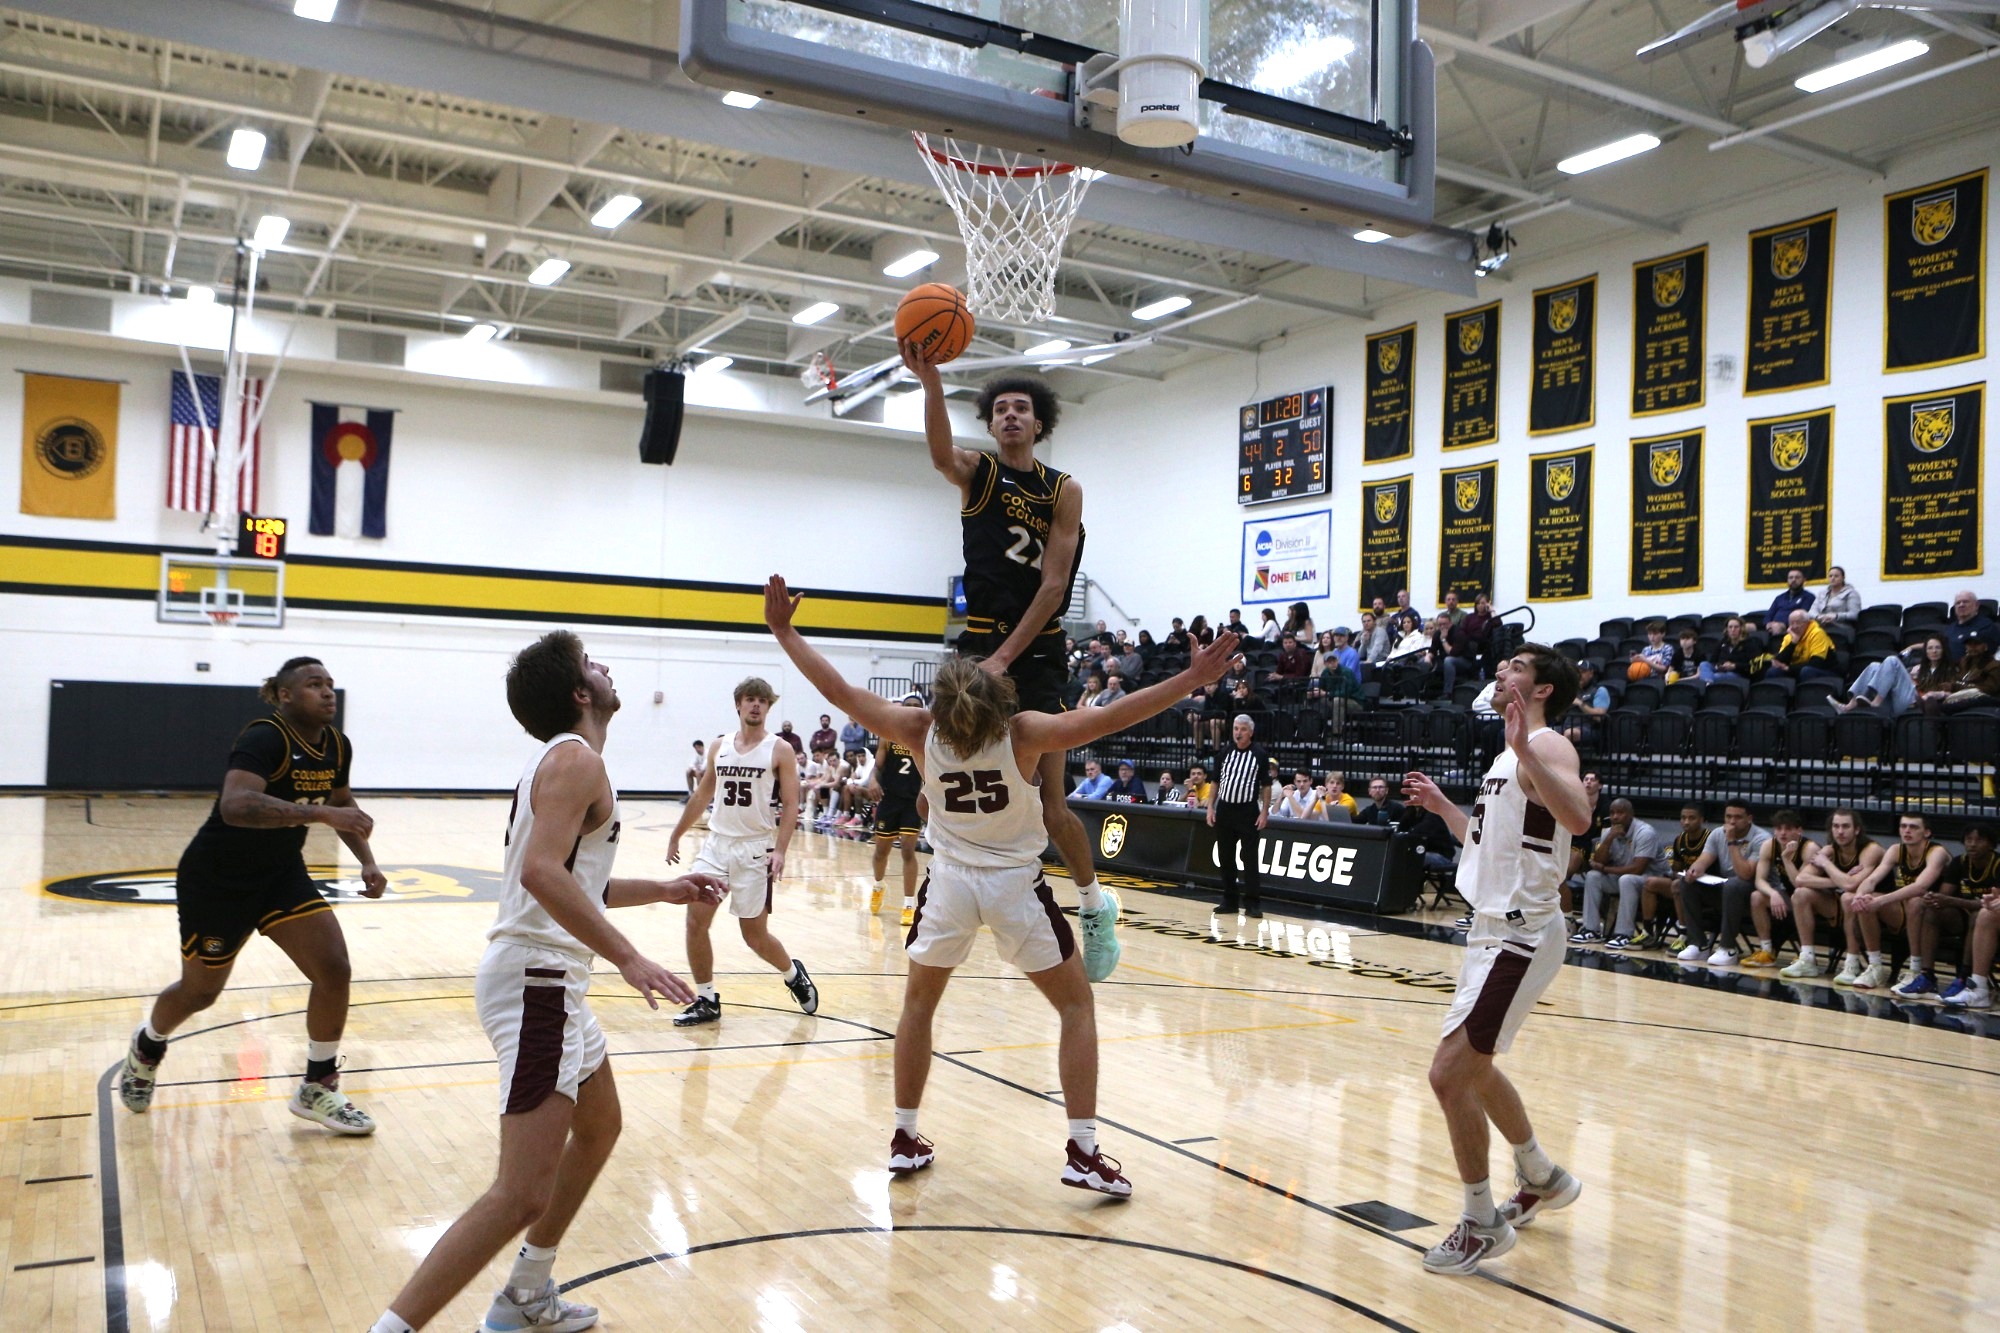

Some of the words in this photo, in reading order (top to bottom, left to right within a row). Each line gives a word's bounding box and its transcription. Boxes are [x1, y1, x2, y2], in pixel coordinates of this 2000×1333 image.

[1908, 248, 1958, 267] WOMEN'S
[1912, 260, 1954, 278] SOCCER
[1266, 394, 1301, 421] 11:28
[1300, 416, 1321, 430] GUEST
[1243, 429, 1261, 442] HOME
[1303, 429, 1321, 453] 50
[1245, 443, 1262, 462] 44
[1276, 439, 1284, 457] 2
[1313, 462, 1321, 480] 5
[1907, 458, 1958, 473] WOMEN'S
[1244, 475, 1251, 492] 6
[1775, 477, 1803, 488] MEN'S
[1911, 470, 1954, 484] SOCCER
[1646, 491, 1684, 503] WOMEN'S
[1770, 487, 1806, 499] SOCCER
[1549, 506, 1570, 516] MEN'S
[1645, 501, 1687, 513] LACROSSE
[1539, 517, 1550, 525] ICE
[1552, 514, 1580, 525] HOCKEY
[1276, 538, 1303, 550] Division
[1271, 569, 1316, 584] ONETEAM
[716, 765, 766, 779] TRINITY
[899, 758, 912, 774] 2
[291, 769, 336, 780] COLORADO
[294, 780, 332, 791] COLLEGE
[939, 770, 1010, 814] 25
[723, 781, 752, 807] 35
[1116, 794, 1132, 803] POSS
[1212, 837, 1358, 886] LLEGE
